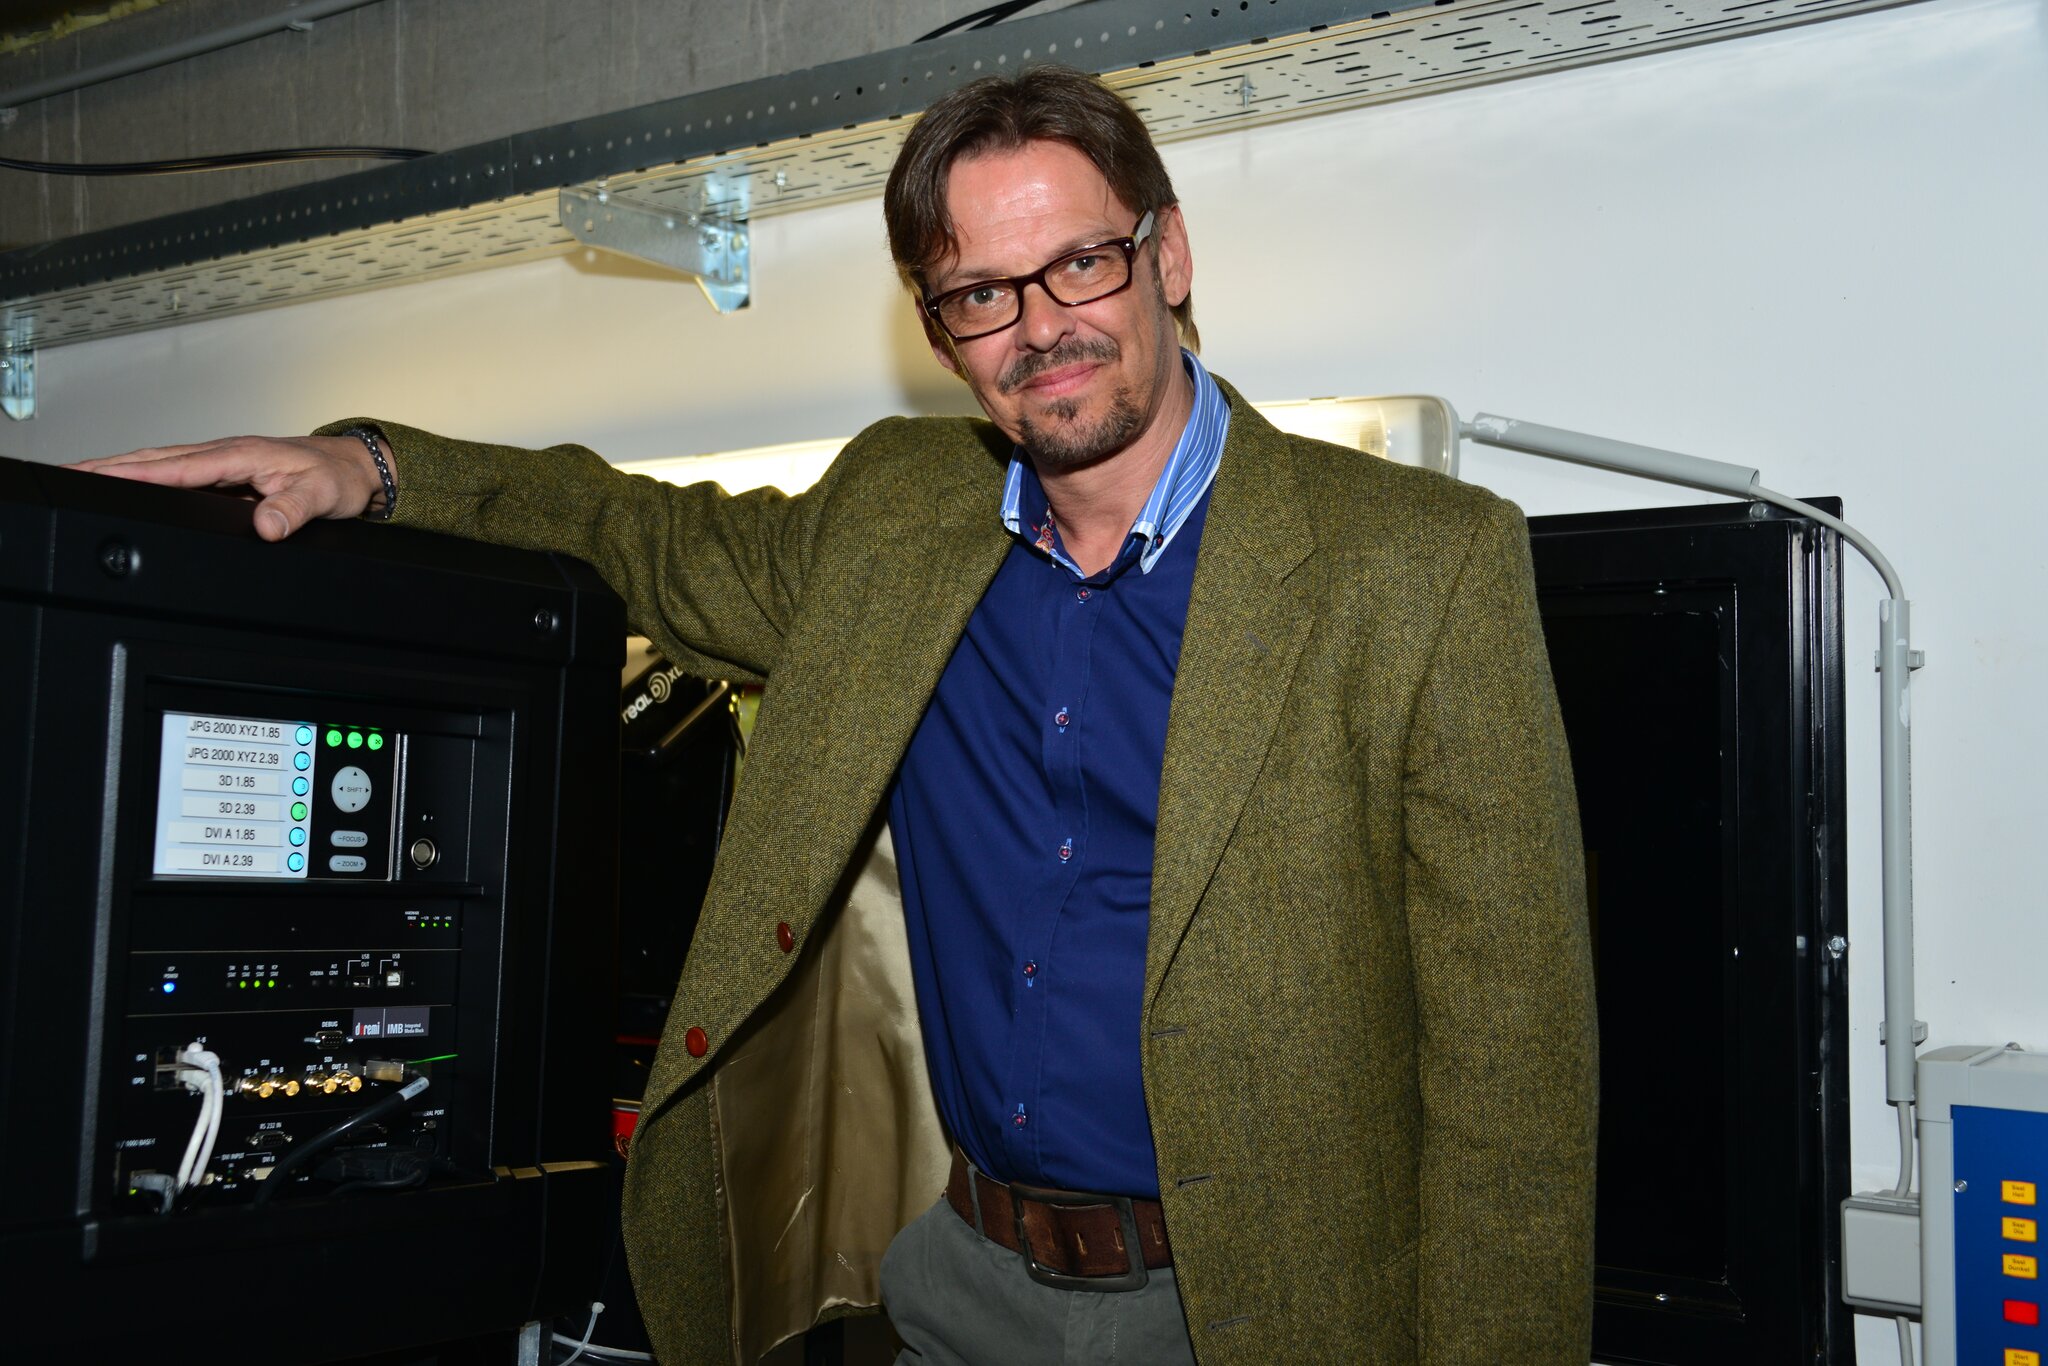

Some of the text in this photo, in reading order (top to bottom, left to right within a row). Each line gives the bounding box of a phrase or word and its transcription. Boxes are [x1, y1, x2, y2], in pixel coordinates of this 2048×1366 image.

[667, 666, 684, 683] XL
[190, 720, 280, 738] JPG 2000 XYZ 1.85
[188, 747, 279, 765] JPG 2000 XYZ 2.39
[219, 775, 255, 788] 3D 1.85
[219, 802, 255, 815] 3D 2.39
[205, 827, 255, 840] DVI A 1.85
[203, 854, 253, 866] DVI A 2.39
[341, 860, 359, 868] ZOOM
[387, 1023, 403, 1034] IMB
